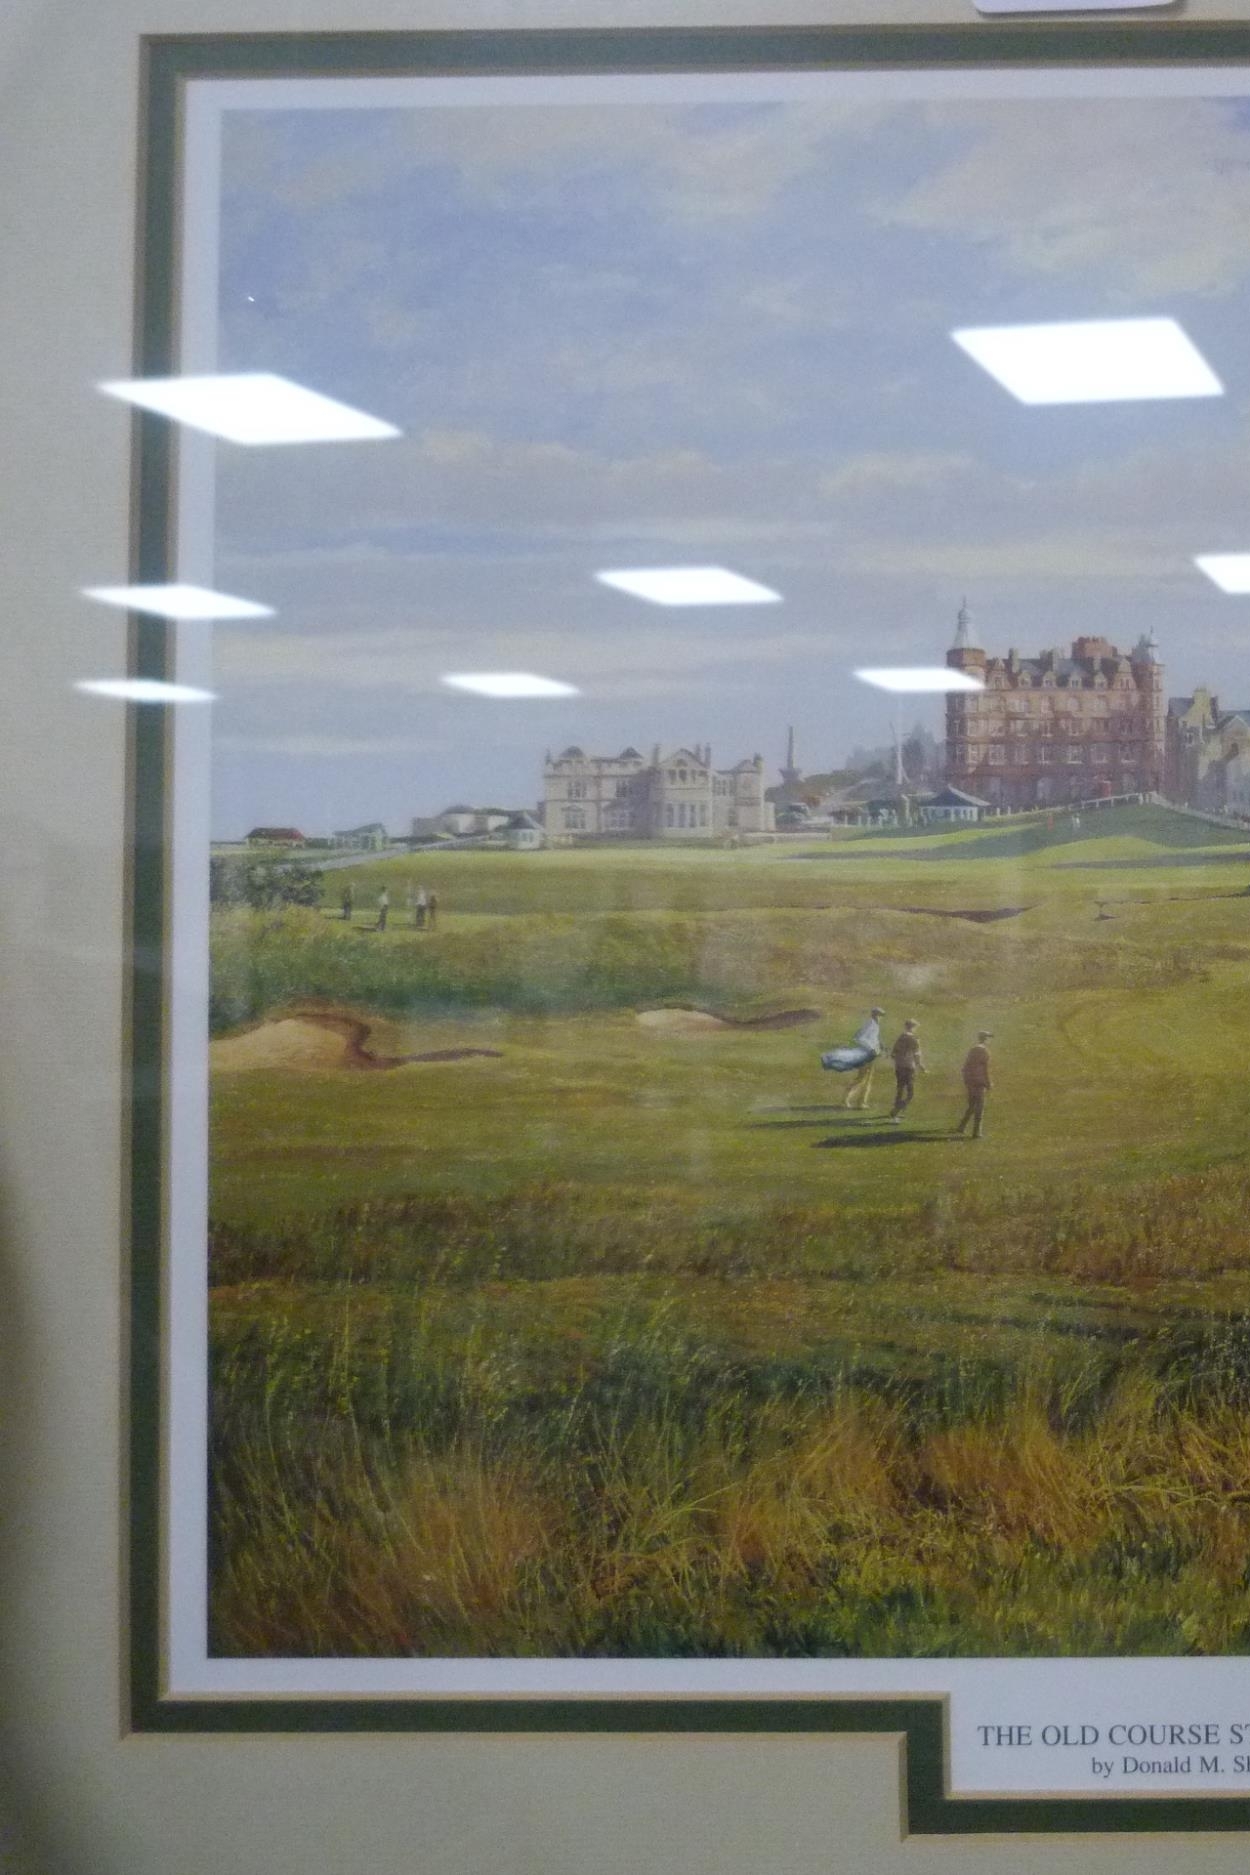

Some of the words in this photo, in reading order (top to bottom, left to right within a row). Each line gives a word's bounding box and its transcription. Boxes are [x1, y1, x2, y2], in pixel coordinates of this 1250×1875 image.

[977, 1726, 1032, 1746] THE
[1042, 1725, 1099, 1746] OLD
[1109, 1724, 1220, 1745] COURSE
[1092, 1757, 1114, 1778] by
[1123, 1756, 1191, 1774] Donald
[1200, 1756, 1224, 1773] M.
